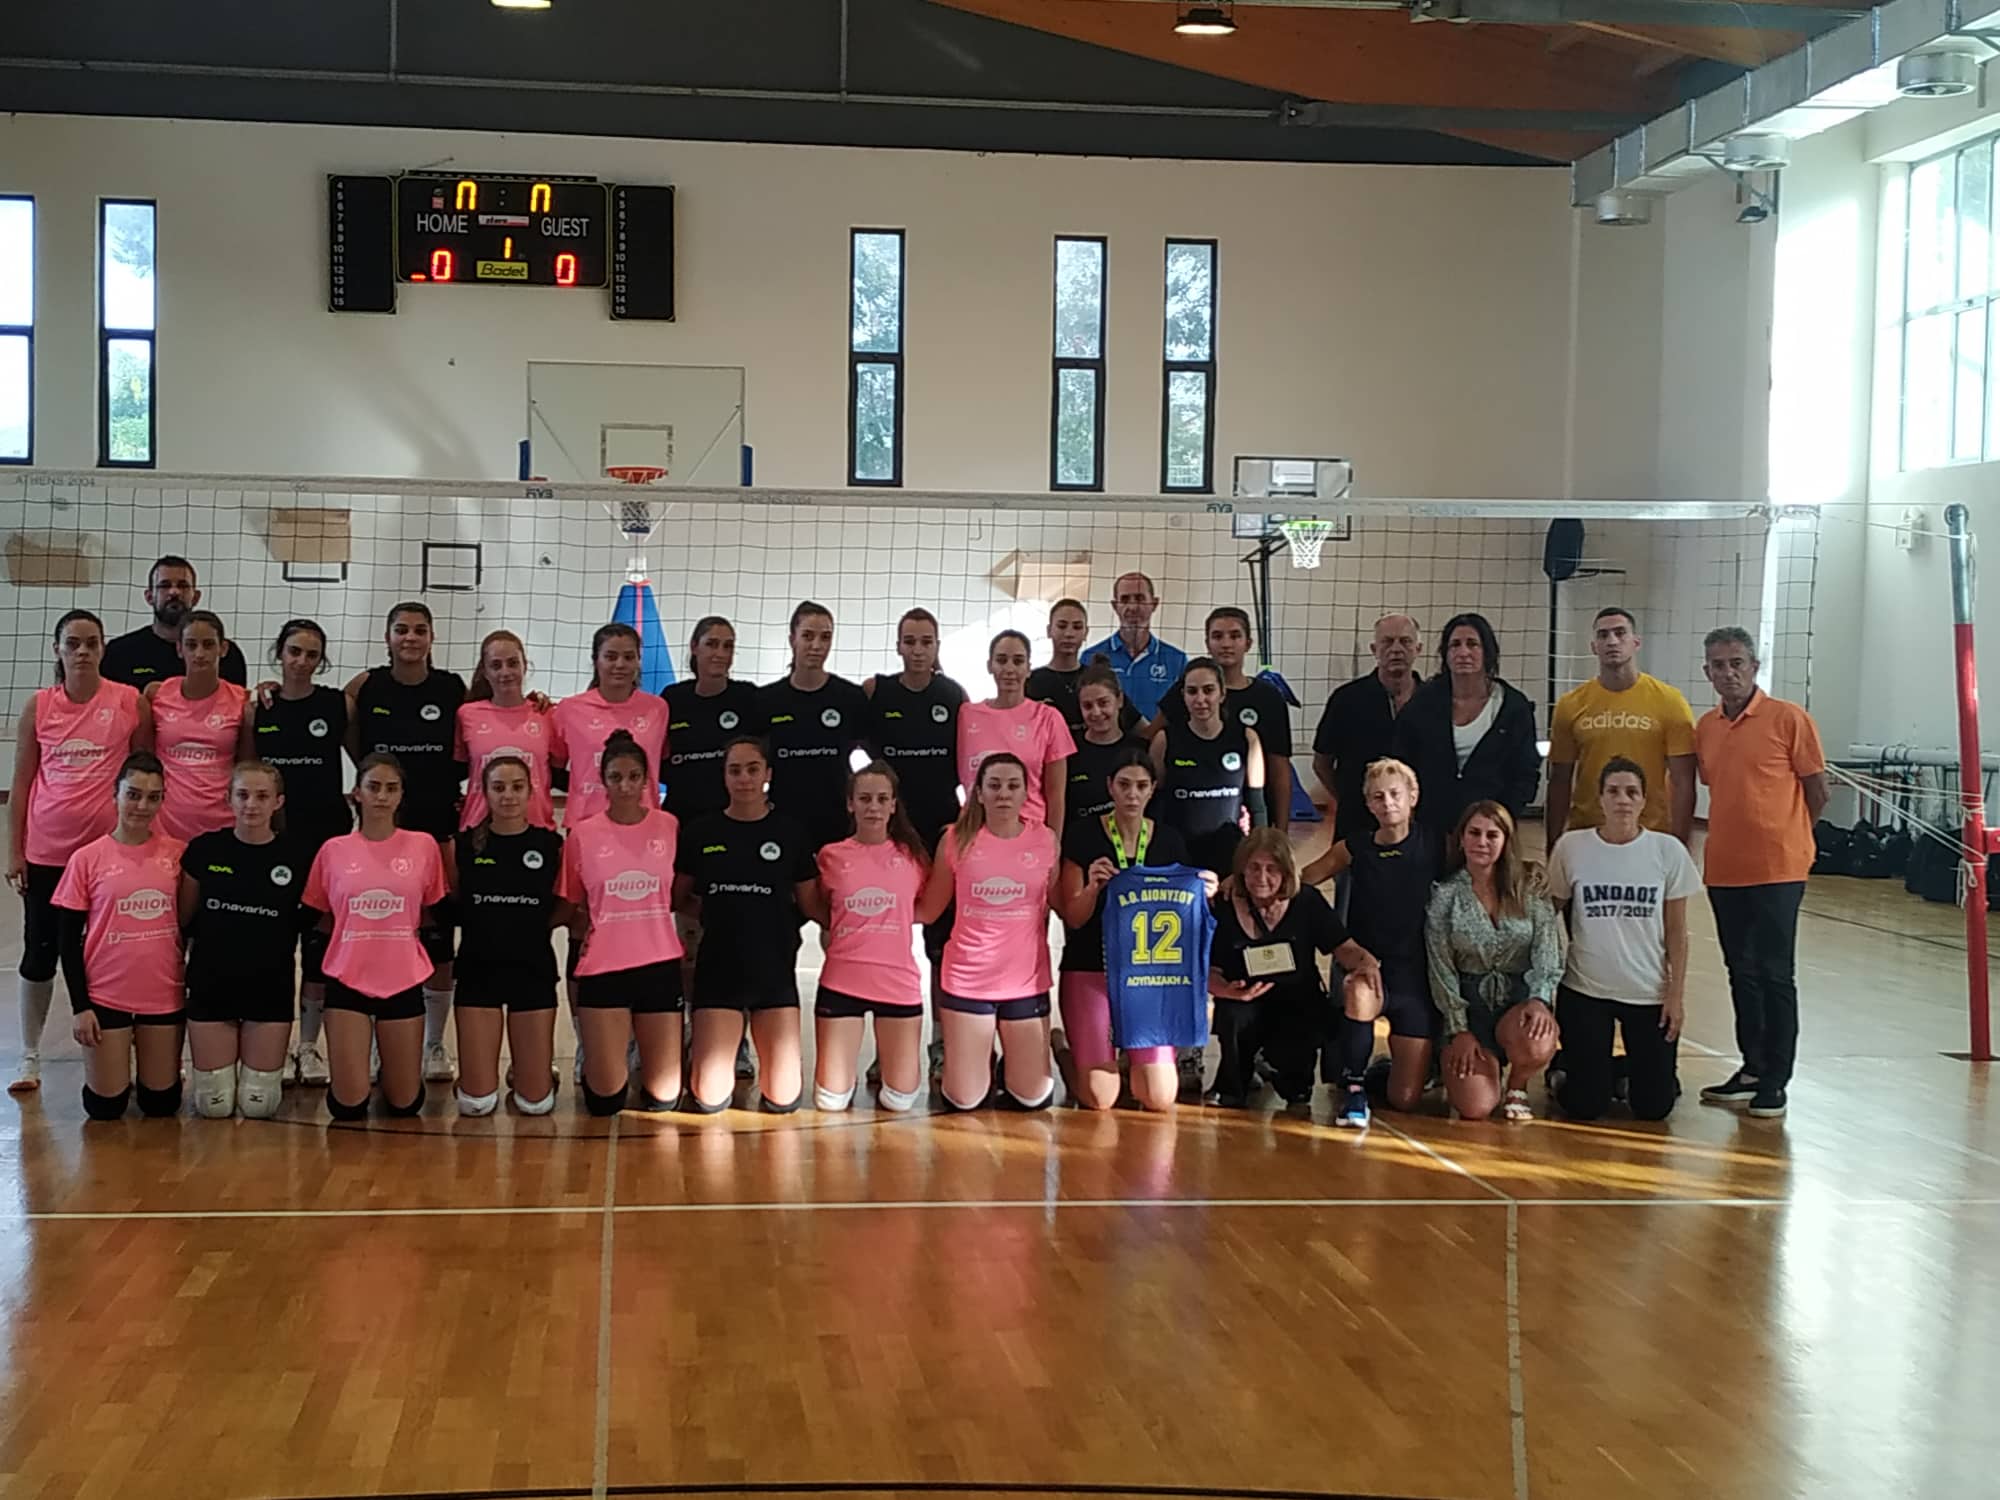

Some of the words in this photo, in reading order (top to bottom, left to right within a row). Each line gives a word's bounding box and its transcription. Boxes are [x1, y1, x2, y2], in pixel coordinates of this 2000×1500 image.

[416, 213, 468, 233] HOME
[541, 217, 590, 238] GUEST
[504, 237, 512, 259] 1
[480, 262, 526, 277] Bodet
[1581, 711, 1652, 731] adidas
[391, 743, 444, 752] navarino
[790, 747, 838, 756] navarino
[897, 747, 948, 756] navarino
[1189, 787, 1240, 798] navarino
[608, 880, 658, 893] UNION
[719, 883, 772, 895] navarino
[973, 886, 1023, 897] UNION
[483, 895, 540, 905] navarino
[1582, 884, 1658, 905] ΑΝΟΔΟΣ
[119, 898, 172, 912] UNION
[351, 899, 402, 911] UNION
[847, 895, 895, 909] UNION
[221, 902, 279, 917] navarino
[1131, 911, 1183, 966] 12
